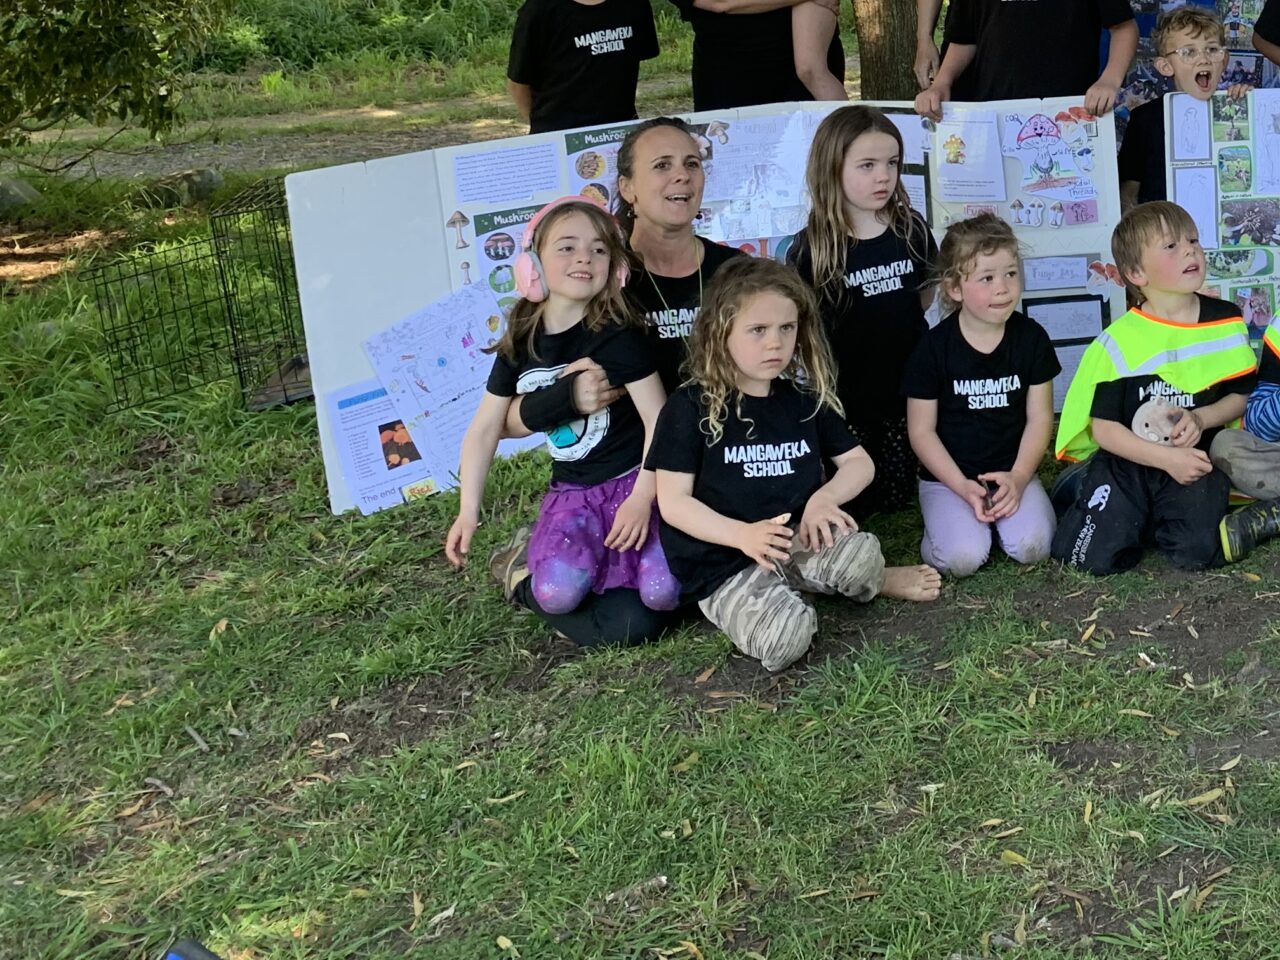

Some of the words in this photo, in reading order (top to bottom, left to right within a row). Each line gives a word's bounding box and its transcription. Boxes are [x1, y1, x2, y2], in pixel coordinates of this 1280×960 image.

[574, 26, 633, 48] MANGAWEKA
[591, 40, 625, 55] SCHOOL
[584, 131, 626, 144] Mushroo
[843, 259, 914, 288] MANGAWEKA
[862, 277, 904, 297] SCHOOL
[658, 321, 693, 339] SCHO
[953, 374, 1021, 395] MANGAWEKA
[968, 393, 1010, 409] SCHOOL
[724, 439, 811, 464] MANGAWEKA
[743, 460, 795, 477] SCHOOL
[361, 493, 380, 505] The
[380, 487, 396, 499] end
